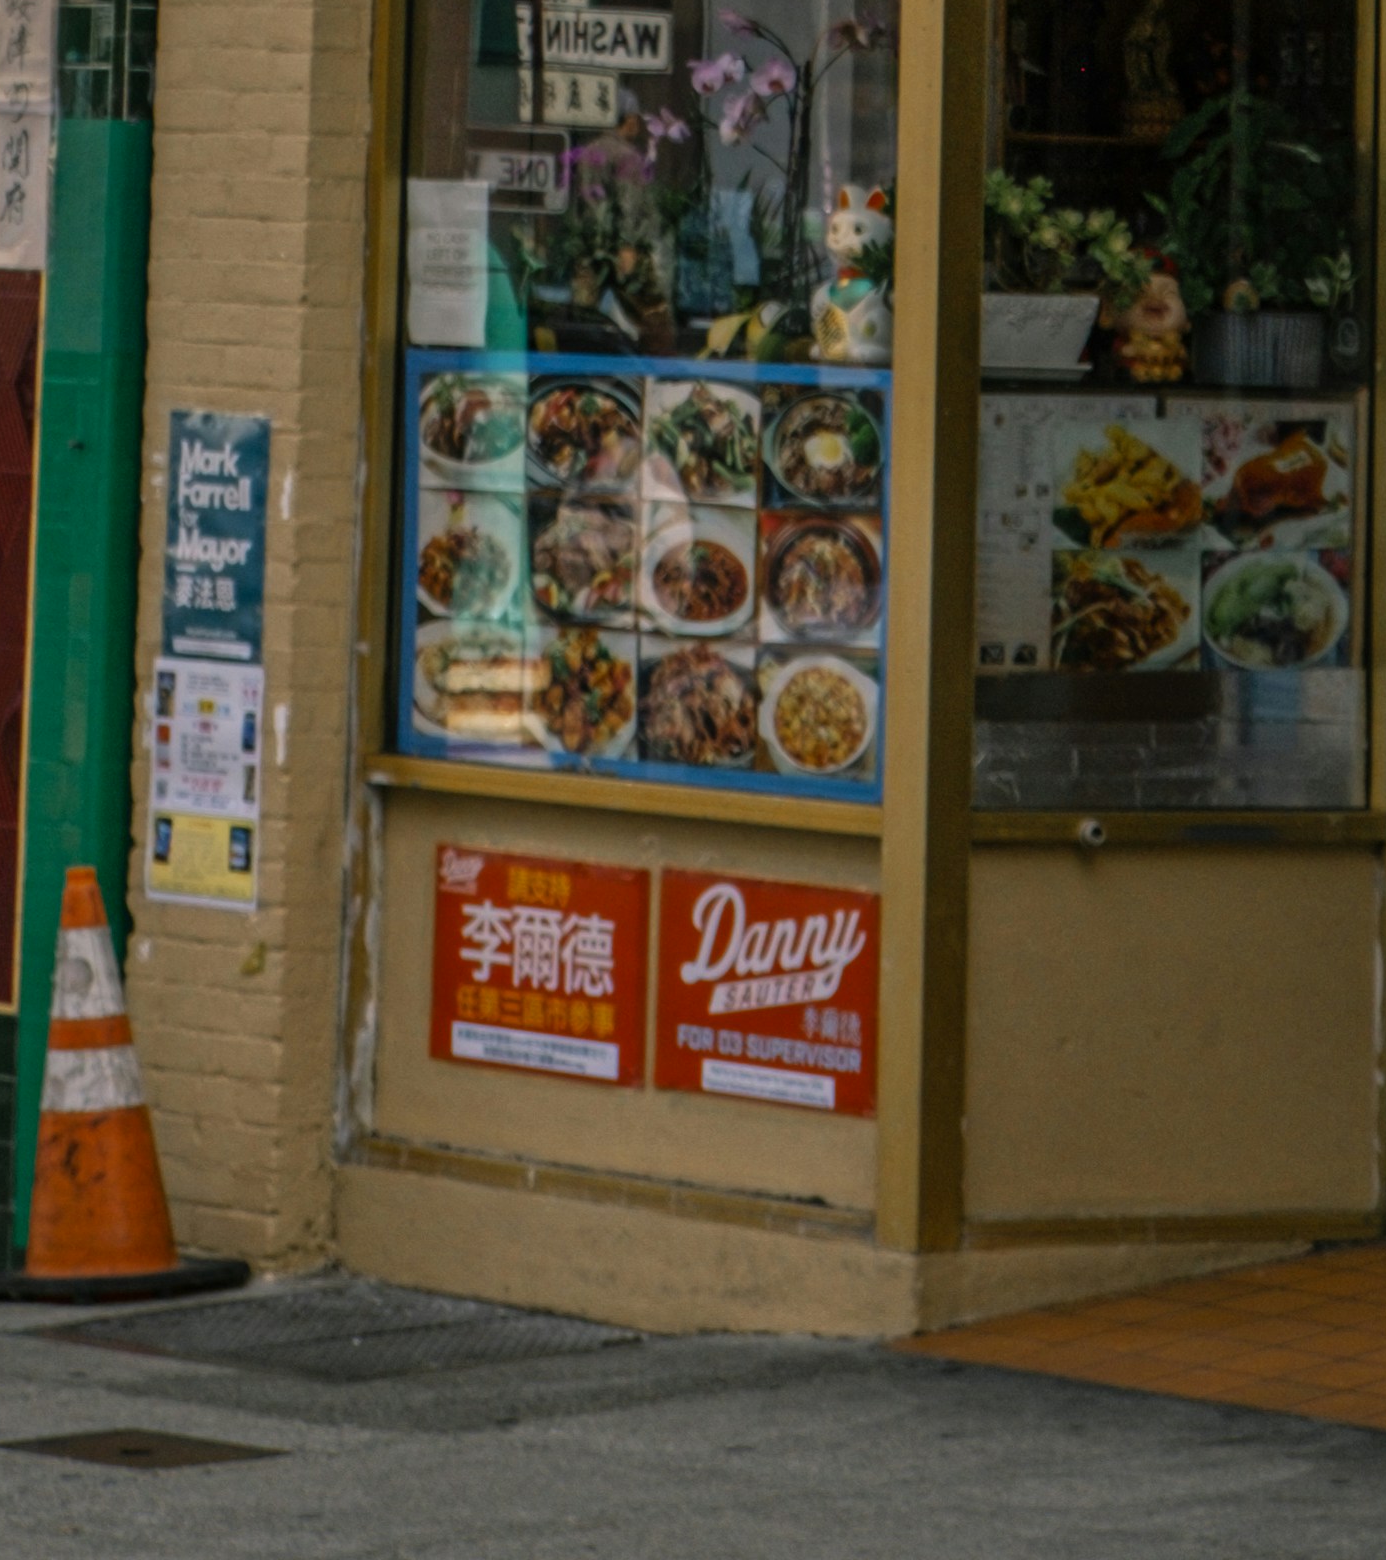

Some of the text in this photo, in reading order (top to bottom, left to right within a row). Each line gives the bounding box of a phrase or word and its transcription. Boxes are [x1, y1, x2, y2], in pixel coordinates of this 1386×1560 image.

[180, 438, 240, 477] Mark
[178, 473, 252, 512] Farrell
[177, 528, 252, 572] Mayor
[460, 898, 616, 997] 李爾德
[680, 882, 866, 988] Danny
[723, 974, 815, 1010] SAUTER
[677, 1023, 714, 1051] FOR
[745, 1032, 862, 1074] SUPERVISOR
